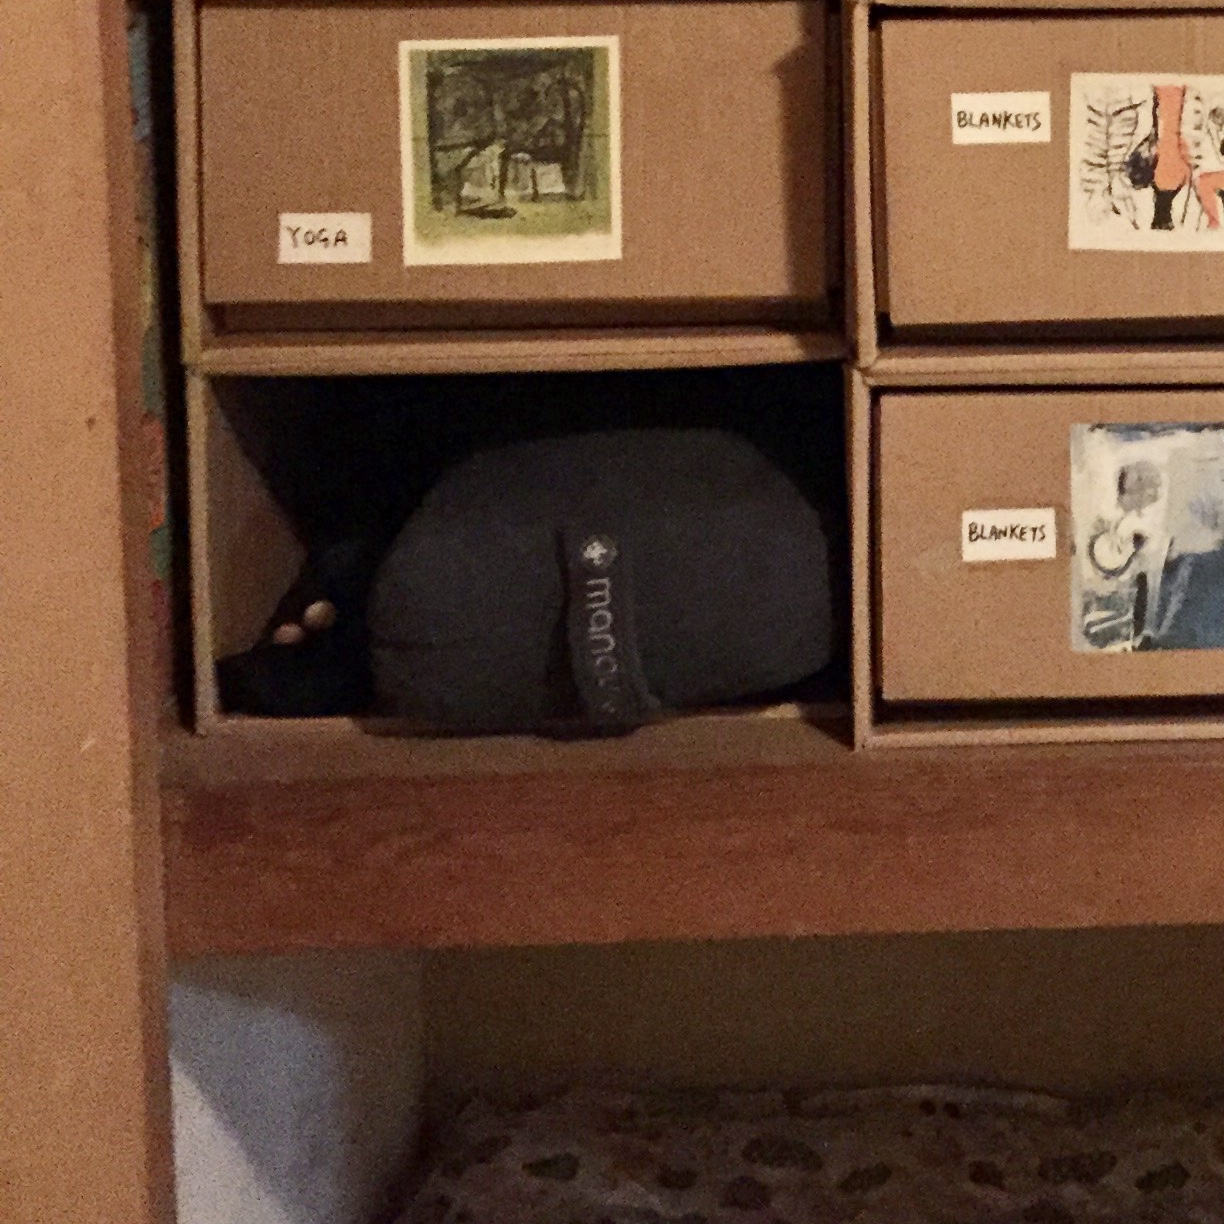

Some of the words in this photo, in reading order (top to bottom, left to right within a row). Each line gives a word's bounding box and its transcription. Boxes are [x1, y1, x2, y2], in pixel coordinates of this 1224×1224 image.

[956, 110, 1041, 132] BLANKETS
[285, 225, 348, 248] YOGA
[968, 521, 1046, 542] BLANKETS
